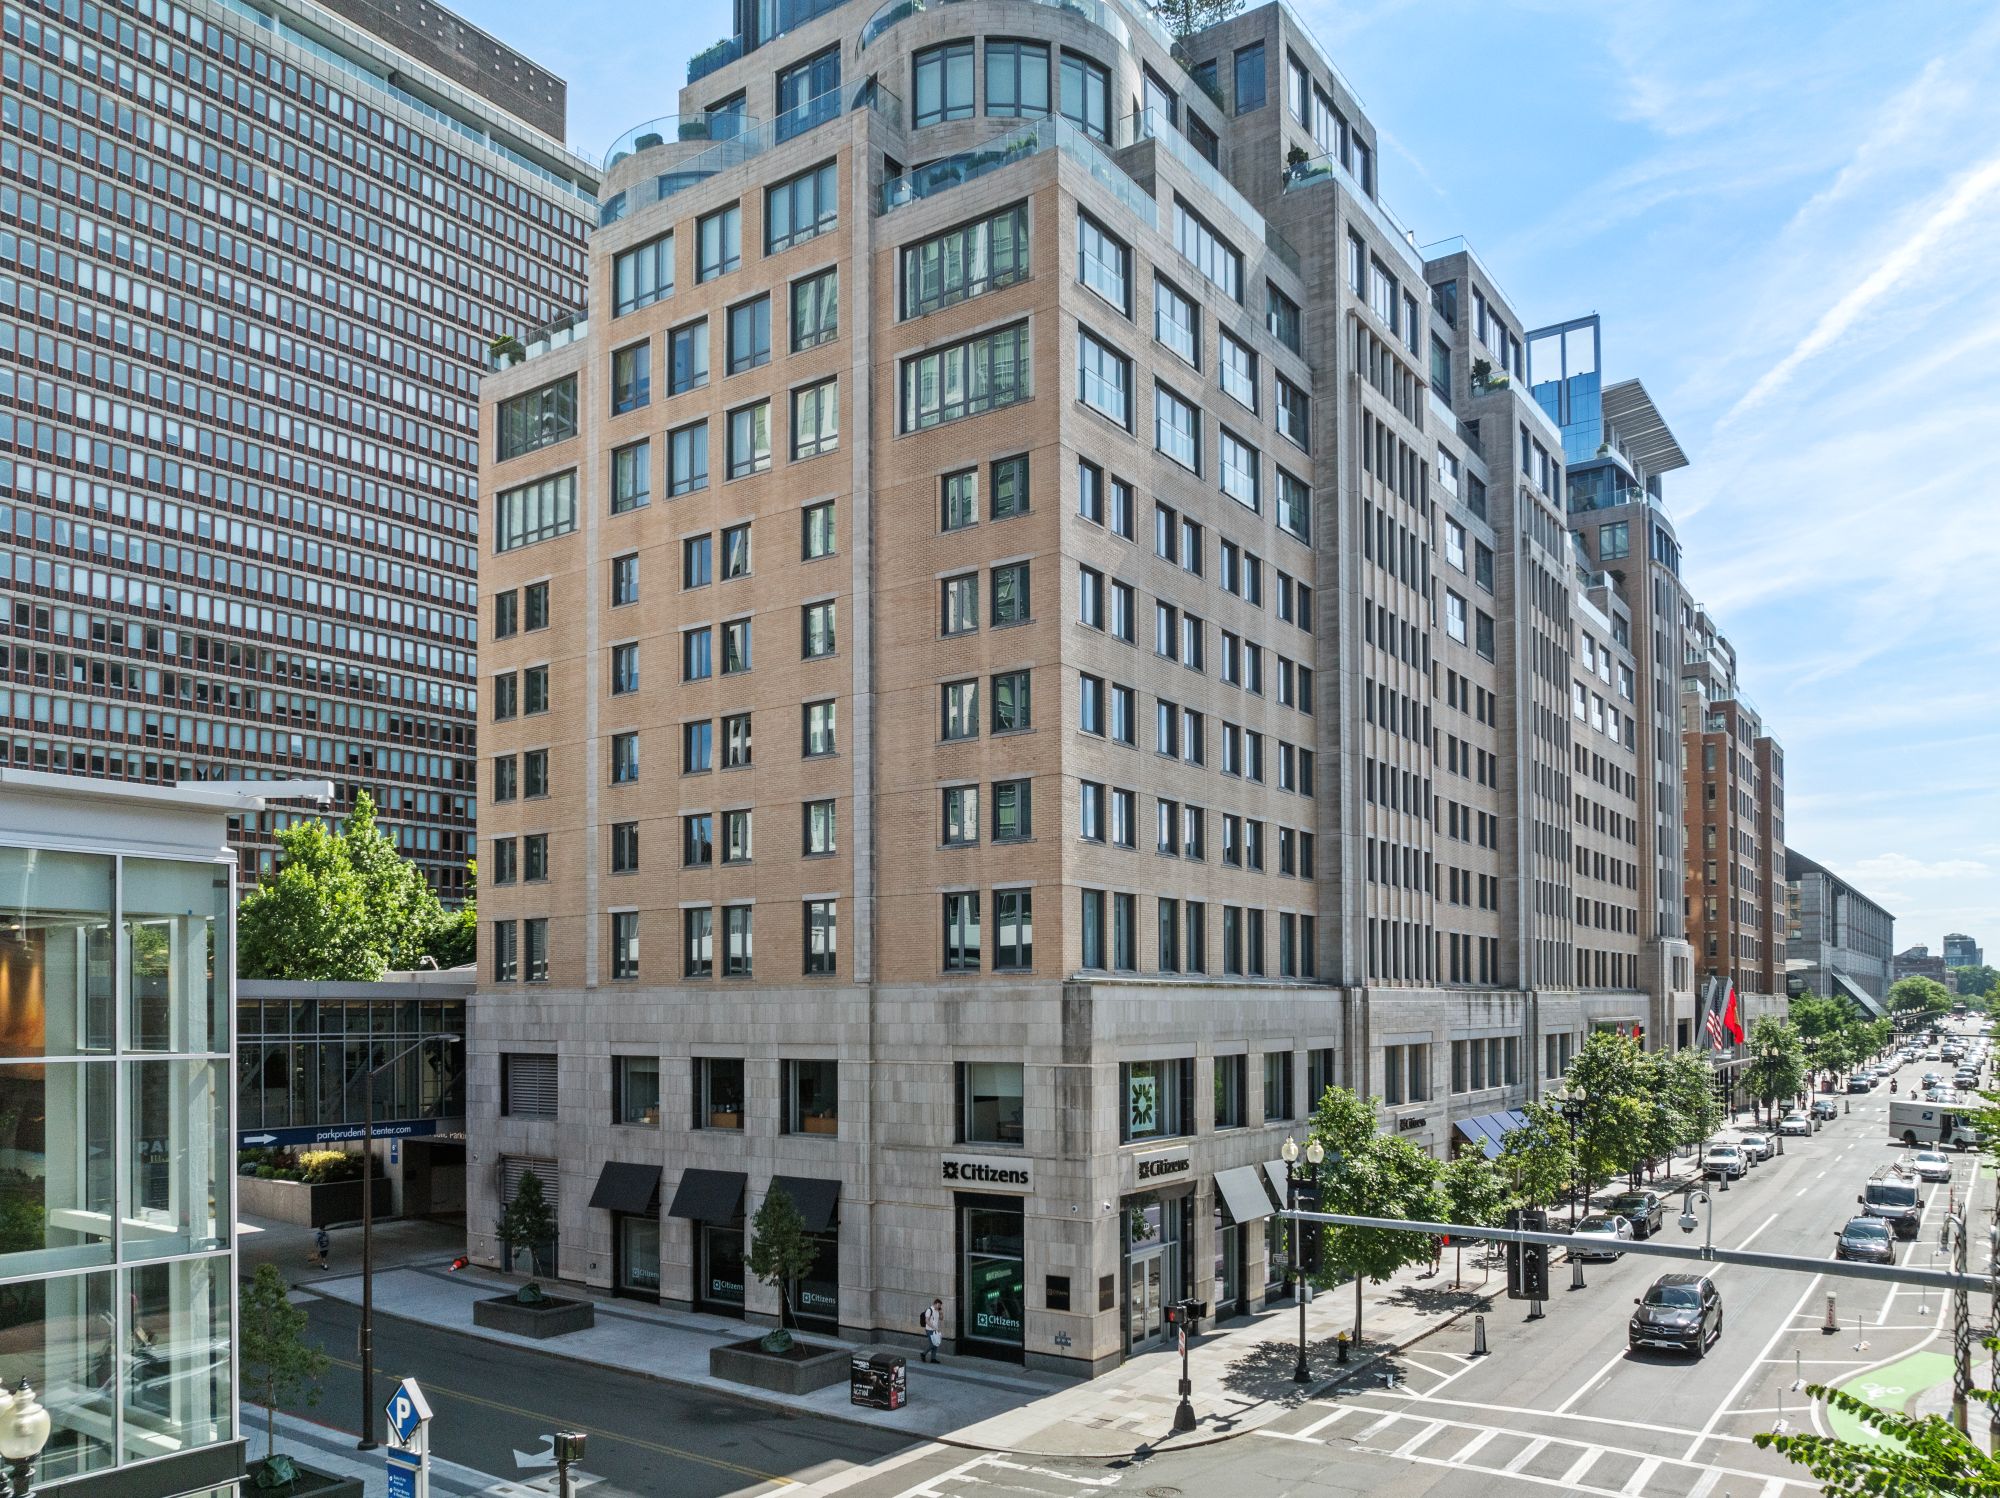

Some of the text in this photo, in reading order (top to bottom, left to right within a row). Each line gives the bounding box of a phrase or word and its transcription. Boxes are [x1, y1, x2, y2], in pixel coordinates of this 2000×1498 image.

[316, 1126, 412, 1142] parkprudentilcenter.com
[960, 1163, 1028, 1184] Citizens
[1150, 1158, 1189, 1176] Citizens
[721, 1280, 744, 1291] Citizens
[811, 1294, 836, 1304] Citizens
[988, 1315, 1020, 1328] Citizens
[396, 1396, 411, 1429] P
